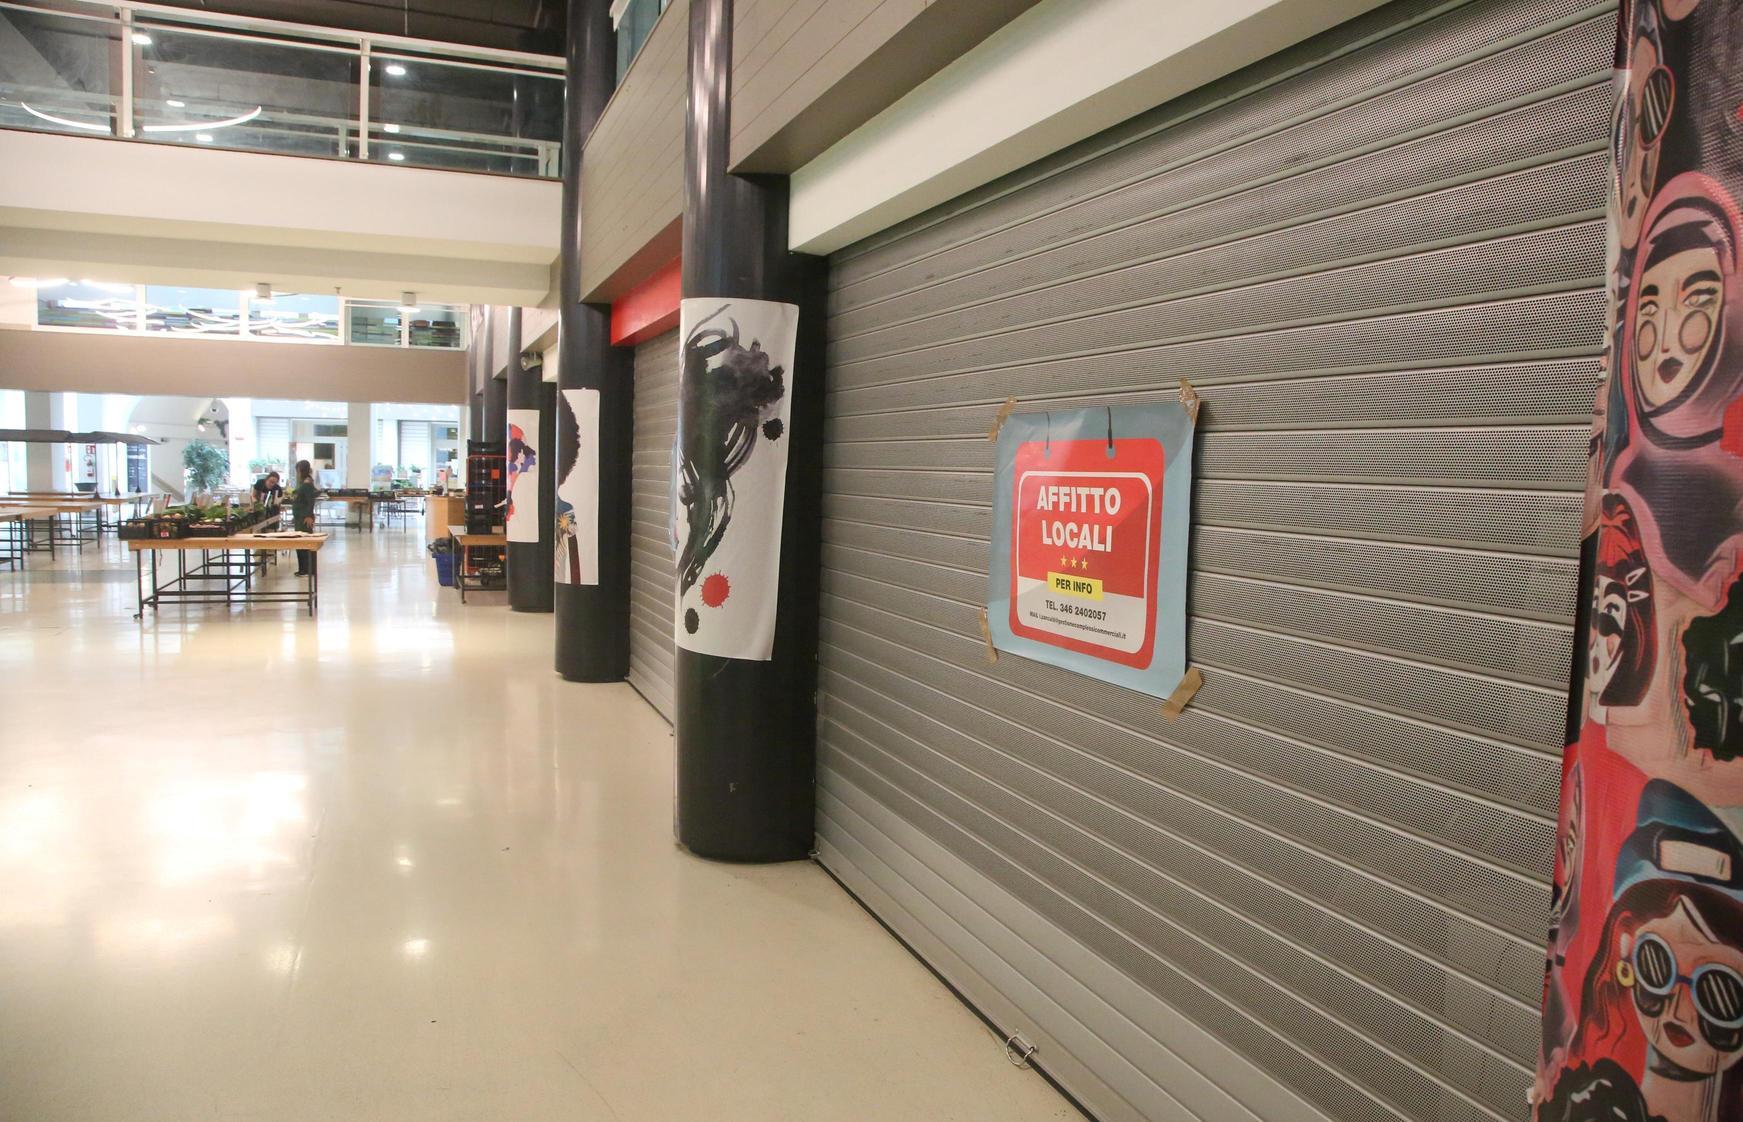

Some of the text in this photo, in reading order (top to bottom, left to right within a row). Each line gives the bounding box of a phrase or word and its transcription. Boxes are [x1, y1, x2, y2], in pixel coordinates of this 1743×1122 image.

[1036, 486, 1121, 516] AFFITTO
[1041, 520, 1113, 553] LOCALI
[1055, 577, 1093, 595] PER INFO
[1045, 599, 1107, 621] TEL. 346 2402057
